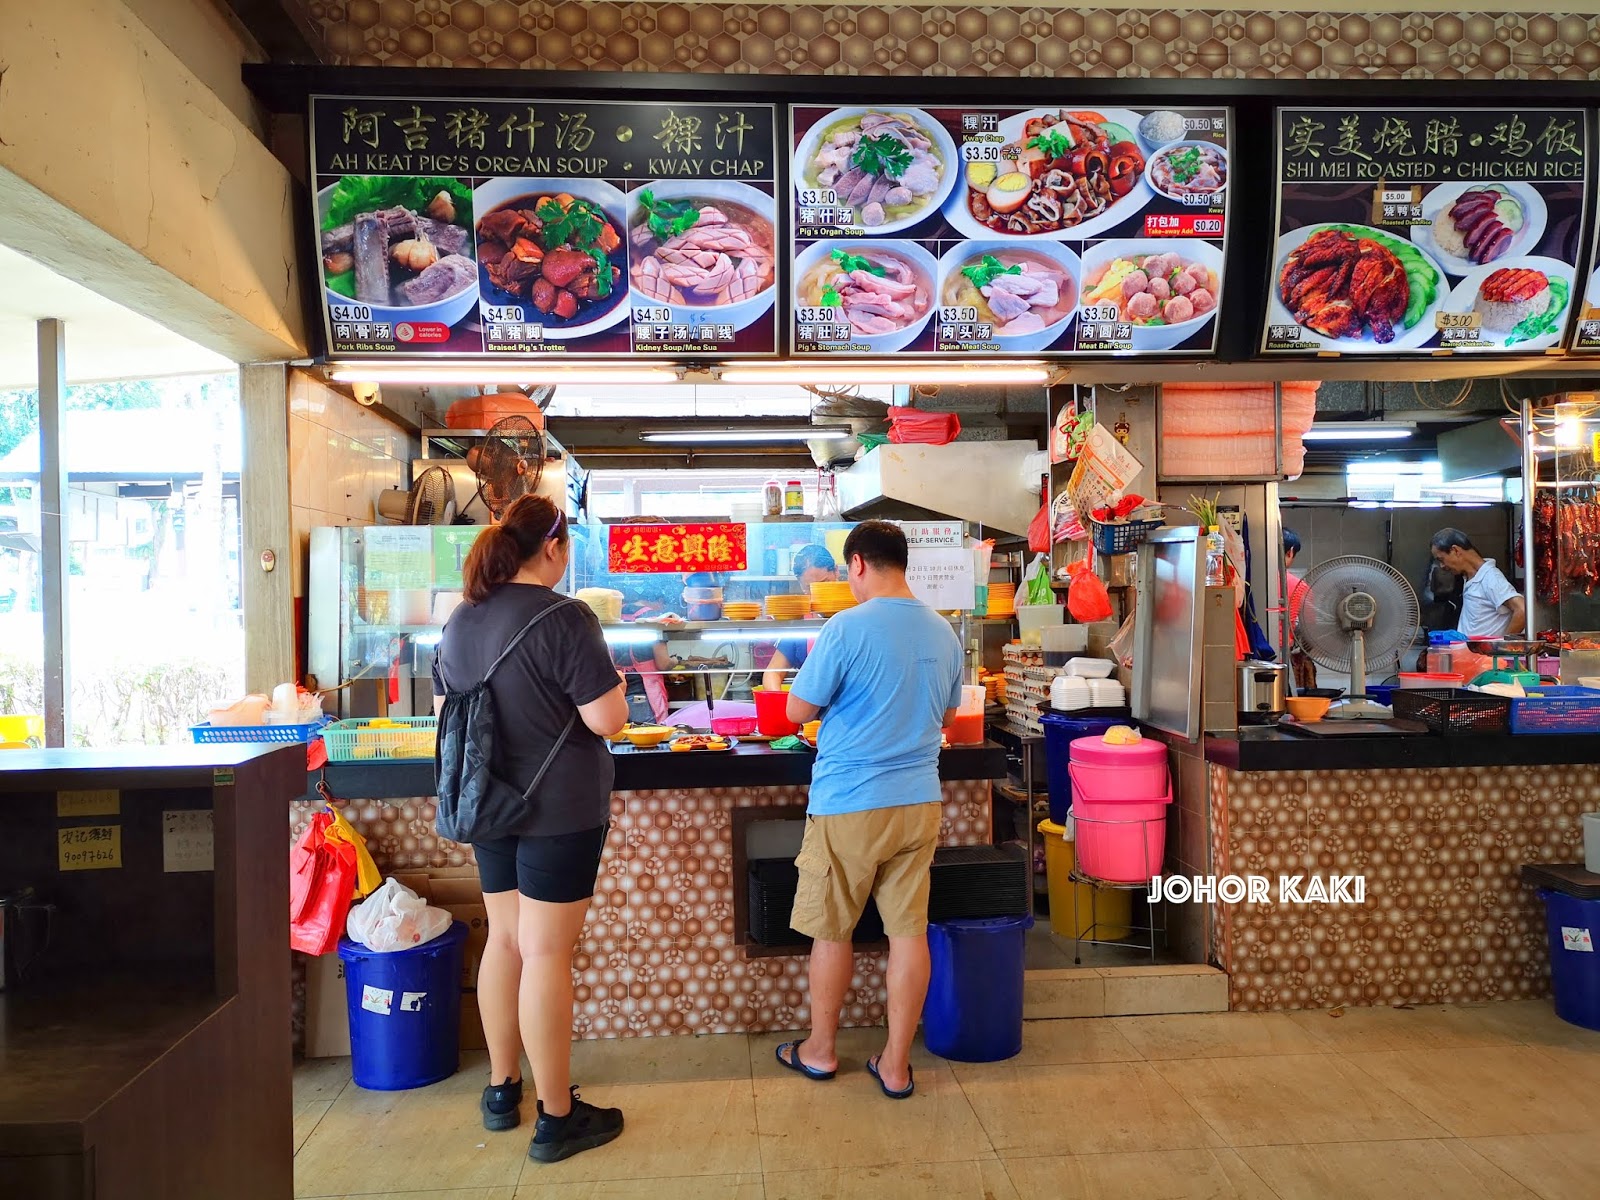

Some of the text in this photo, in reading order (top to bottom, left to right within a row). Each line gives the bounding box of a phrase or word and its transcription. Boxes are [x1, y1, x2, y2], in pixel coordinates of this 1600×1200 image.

[964, 115, 998, 131] 粿汁
[1184, 119, 1209, 130] $0.50
[962, 134, 1005, 143] Kway Chap
[1487, 113, 1583, 158] 鸡饭
[965, 146, 998, 160] $3.50
[329, 153, 764, 176] AH KEAT PIG'S ORGAN SOUP KWAY CHAP
[1286, 161, 1583, 178] SHI MEI ROASTED CHICKEN RICE
[1183, 196, 1209, 205] $0.50
[1147, 216, 1180, 228] 打包加
[1195, 220, 1220, 231] $0.20
[799, 227, 865, 237] Pig's Organ Soup
[334, 305, 370, 321] $4.00
[488, 306, 522, 321] $4.50
[637, 307, 670, 322] $4.50
[800, 308, 833, 322] $3.50
[943, 307, 975, 322] $3.50
[1084, 307, 1116, 321] $3.50
[1440, 313, 1473, 327] $3.00
[335, 324, 391, 340] 肉骨汤
[489, 324, 541, 340] 卤猪脚
[799, 325, 850, 340] 猪肚汤
[336, 343, 396, 352] Pork Ribs Soup
[488, 343, 566, 352] Braised Pig's Trotter
[635, 343, 661, 352] Kidney
[702, 343, 718, 351] Sua
[797, 343, 871, 352] Pig's Stomach Soup
[939, 343, 1001, 351] Spine Meat Soup
[1079, 342, 1133, 351] Meat Ball Soup
[621, 534, 735, 564] 生意興隆
[64, 848, 114, 862] 90097626
